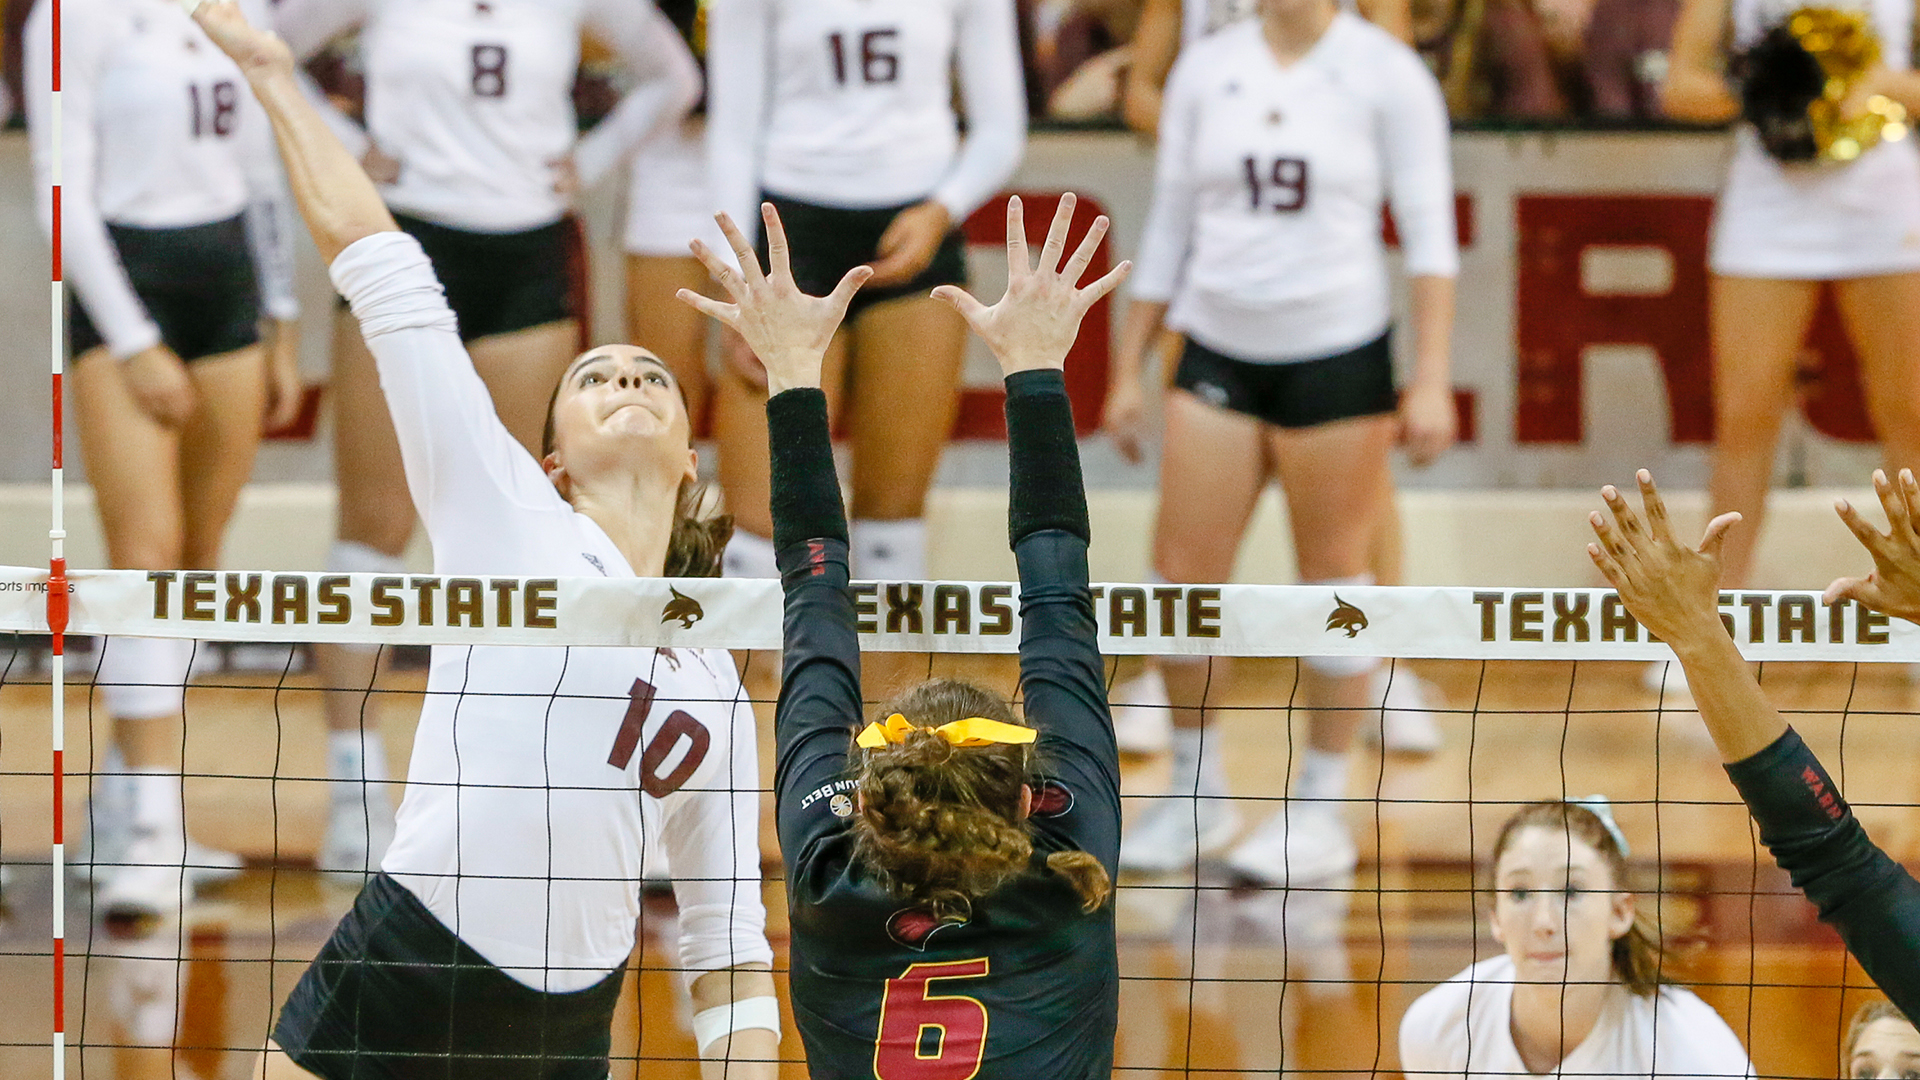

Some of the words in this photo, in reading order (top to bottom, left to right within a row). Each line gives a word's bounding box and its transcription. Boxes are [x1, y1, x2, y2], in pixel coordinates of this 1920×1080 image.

[472, 44, 508, 98] 8
[827, 29, 898, 84] 16
[188, 80, 238, 137] 18
[1243, 156, 1307, 212] 19
[146, 571, 352, 625] TEXAS
[370, 576, 558, 629] STATE
[849, 582, 1014, 636] EXAS
[1089, 586, 1222, 638] ATE
[1472, 591, 1667, 643] TEXA
[606, 676, 711, 799] 10
[801, 783, 835, 810] BELT
[873, 956, 990, 1080] 6
